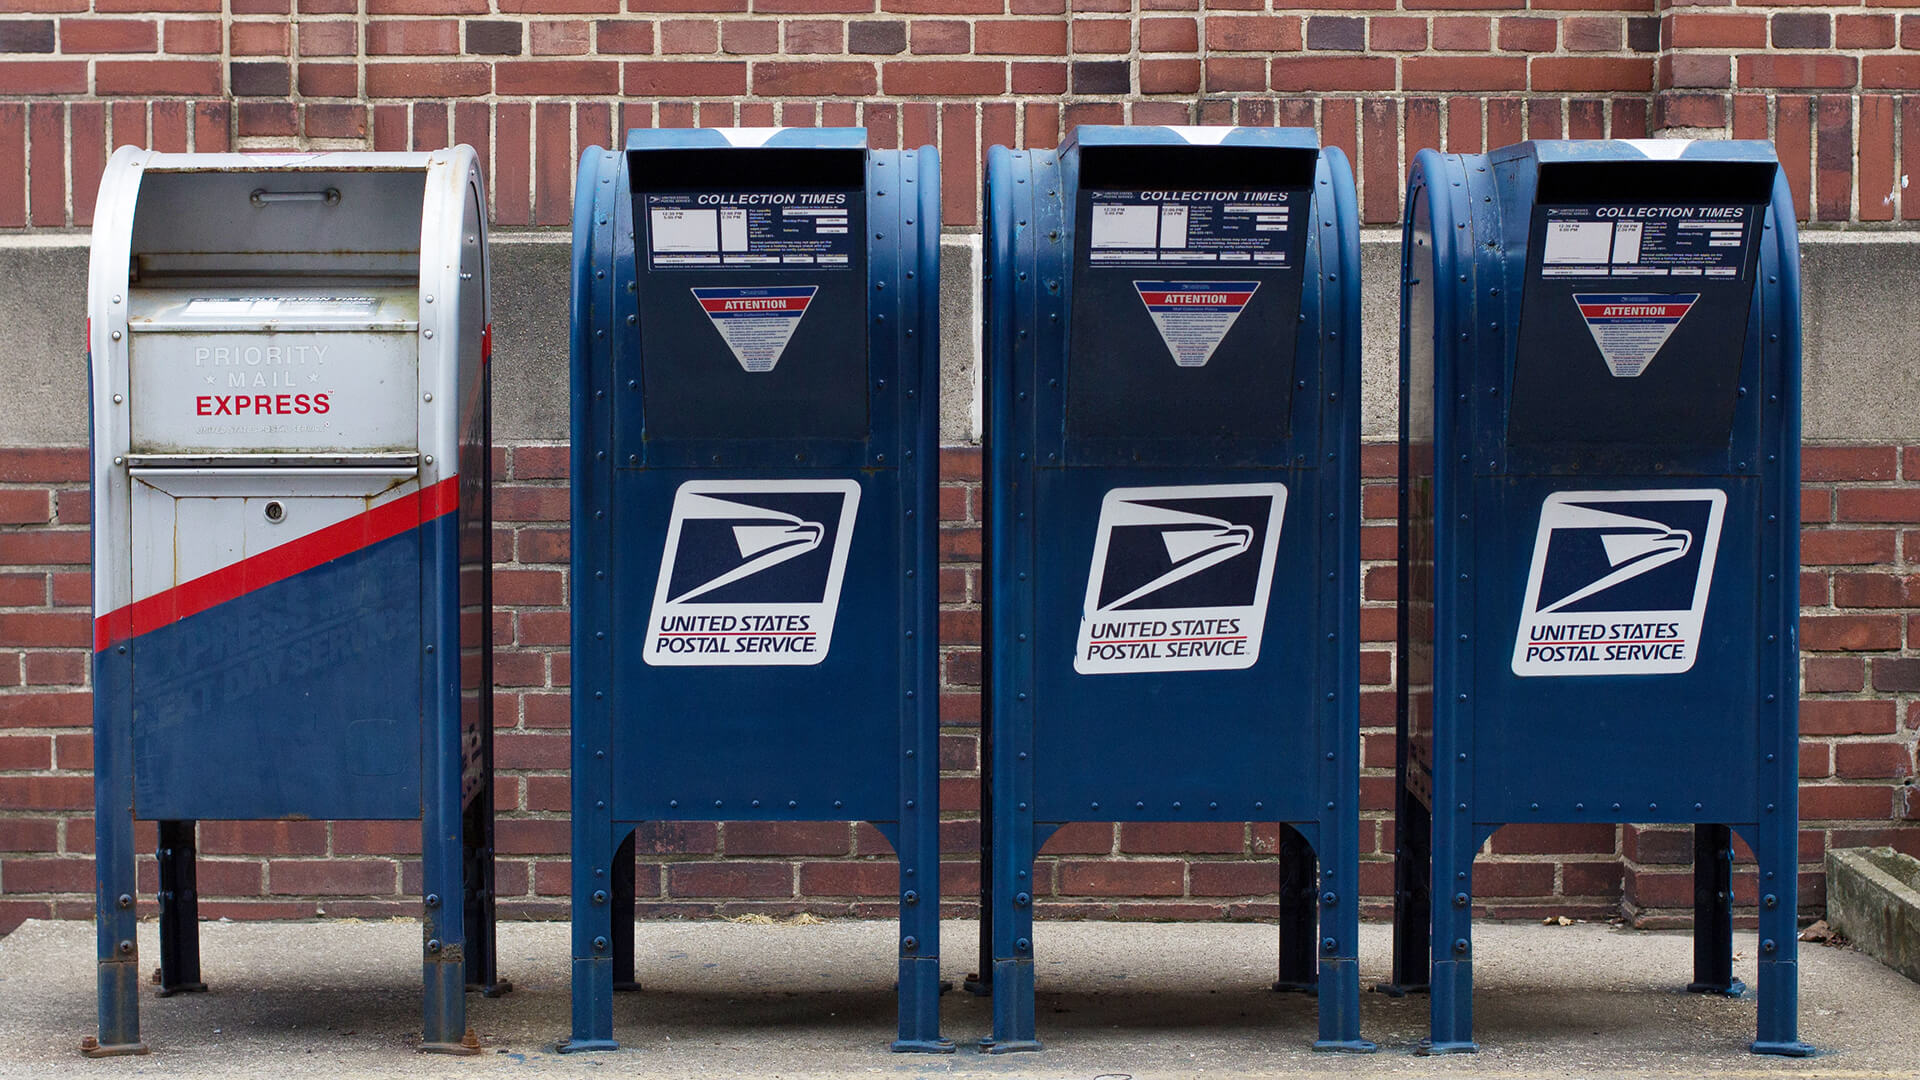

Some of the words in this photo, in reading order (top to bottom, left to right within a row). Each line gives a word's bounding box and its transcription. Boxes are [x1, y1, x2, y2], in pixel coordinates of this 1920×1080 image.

[698, 194, 796, 204] COLLECTION
[800, 194, 846, 204] TIMES
[1140, 191, 1238, 201] COLLECTION
[1243, 191, 1289, 201] TIMES
[1596, 207, 1695, 218] COLLECTION
[1698, 207, 1744, 218] TIMES
[724, 300, 787, 310] ATTENTION
[1164, 294, 1227, 303] ATTENTION
[1603, 306, 1666, 315] ATTENTION
[194, 344, 330, 366] PRIORITY
[228, 371, 298, 388] MAIL
[196, 393, 330, 416] EXPRESS
[660, 616, 736, 632] UNITED
[740, 616, 810, 631] STATES
[1091, 621, 1167, 638] UNITED
[1170, 618, 1240, 636] STATES
[1530, 624, 1606, 641] UNITED
[1609, 623, 1679, 639] STATES
[656, 638, 730, 653] POSTAL
[1087, 643, 1161, 660] POSTAL
[1526, 646, 1600, 662] POSTAL
